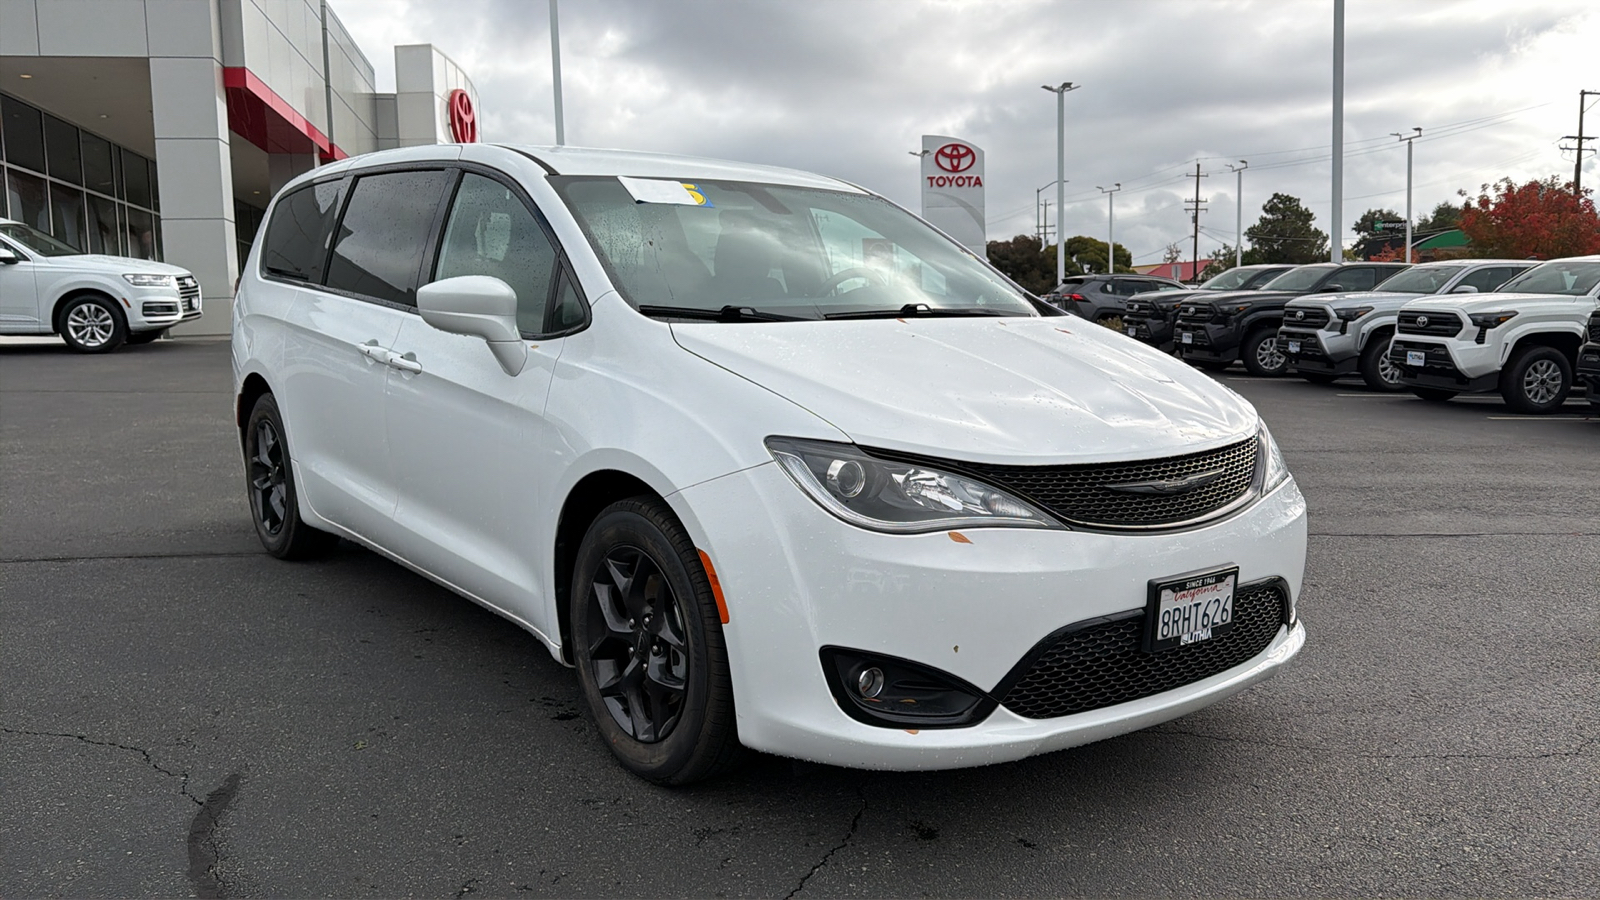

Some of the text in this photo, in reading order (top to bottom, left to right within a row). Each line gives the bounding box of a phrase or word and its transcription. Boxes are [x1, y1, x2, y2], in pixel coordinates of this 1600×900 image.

[926, 175, 983, 188] TOYOTA
[1185, 579, 1203, 589] SINCE
[1174, 584, 1223, 602] California
[1160, 594, 1231, 638] 8RHT626
